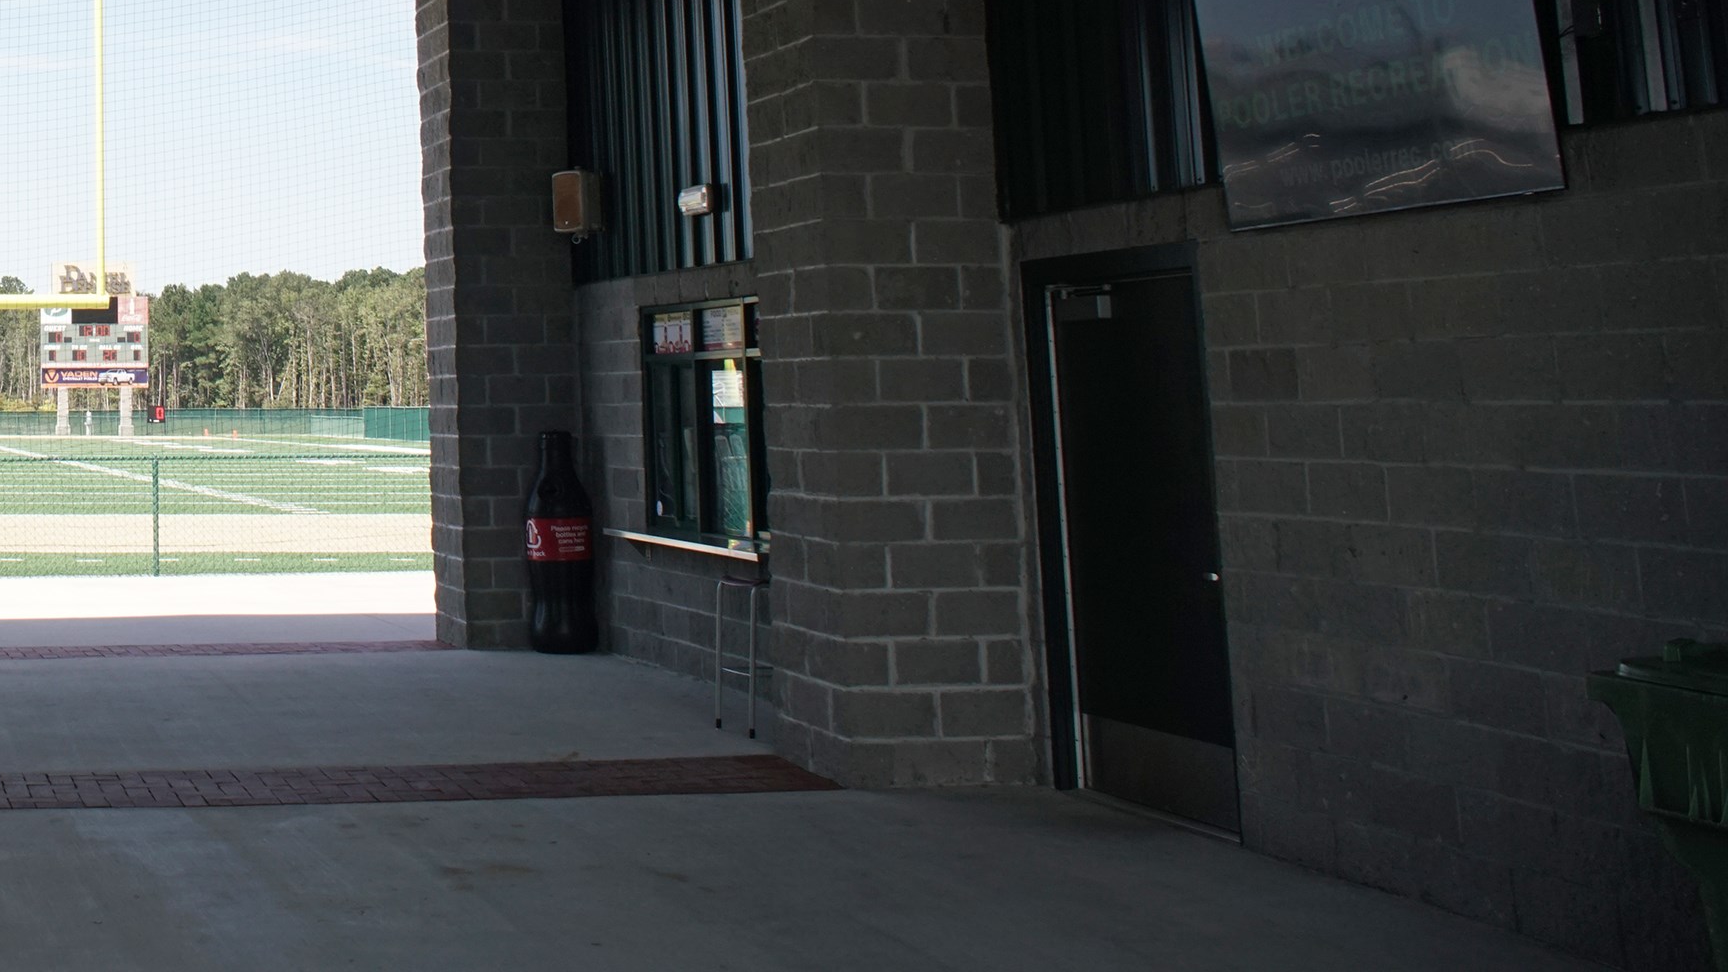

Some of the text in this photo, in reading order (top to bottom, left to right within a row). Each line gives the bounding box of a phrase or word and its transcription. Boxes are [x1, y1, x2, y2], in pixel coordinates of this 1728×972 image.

[1256, 5, 1405, 67] WELCOME
[1216, 35, 1532, 132] POOLER RECREAON
